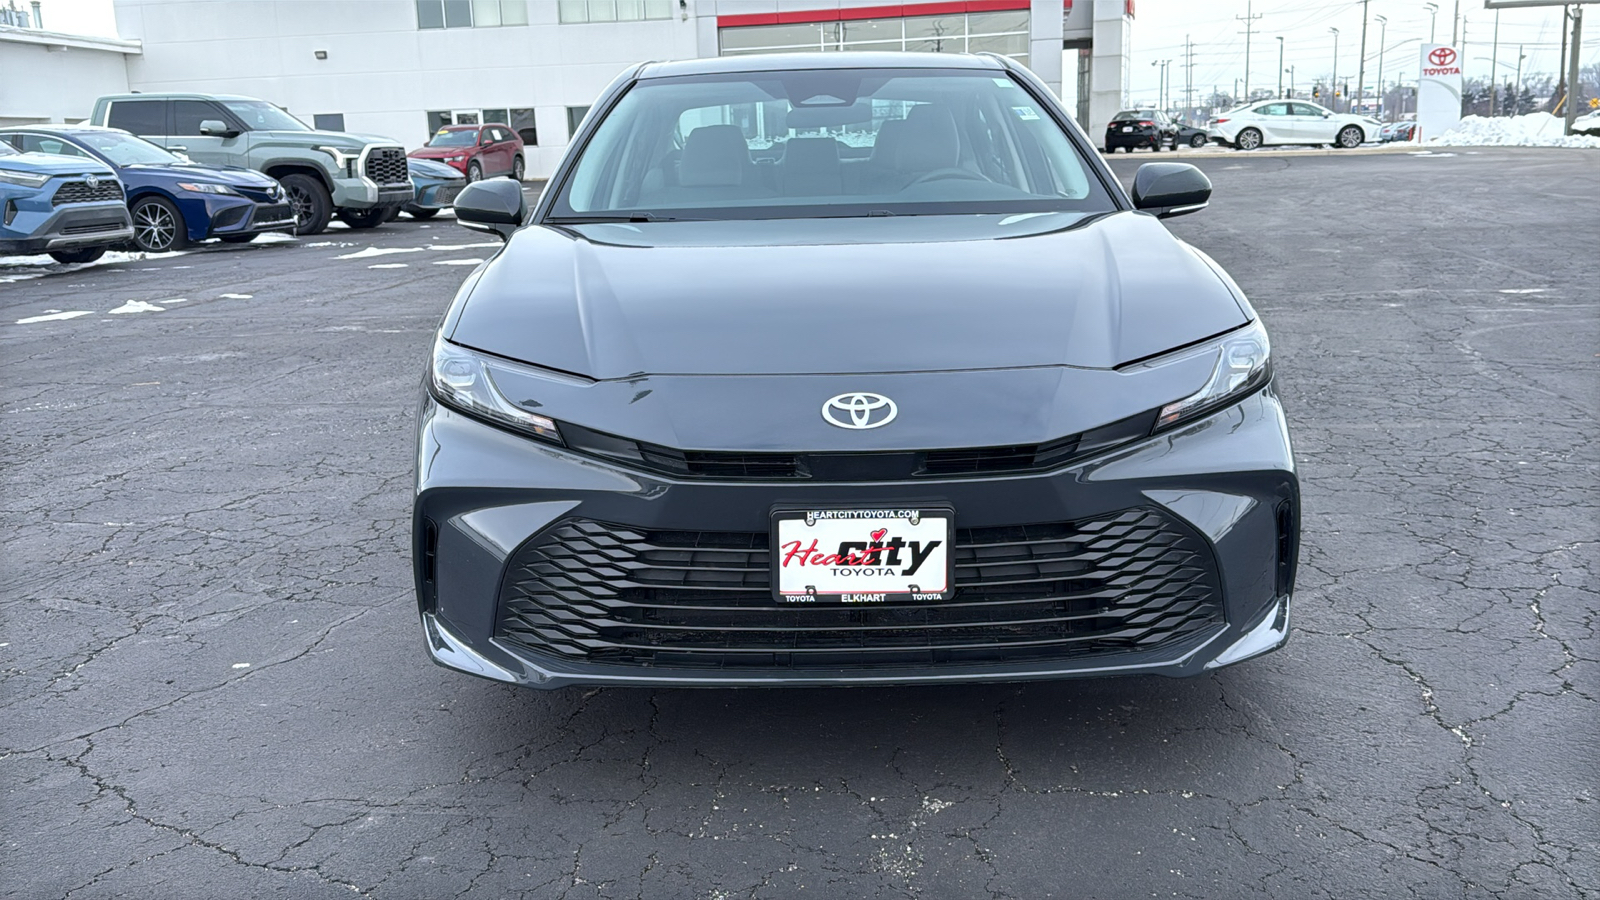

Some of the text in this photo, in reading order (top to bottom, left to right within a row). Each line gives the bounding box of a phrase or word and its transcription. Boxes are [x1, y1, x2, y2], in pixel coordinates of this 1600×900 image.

[1423, 67, 1460, 76] TOYOTA
[807, 510, 919, 519] HEARTCITYTOYOTA.COM
[781, 538, 895, 568] Heart
[830, 568, 895, 576] TOYOTA
[785, 595, 816, 603] TOYOTA
[841, 593, 887, 603] ELKHART
[912, 593, 943, 601] TOYOTA
